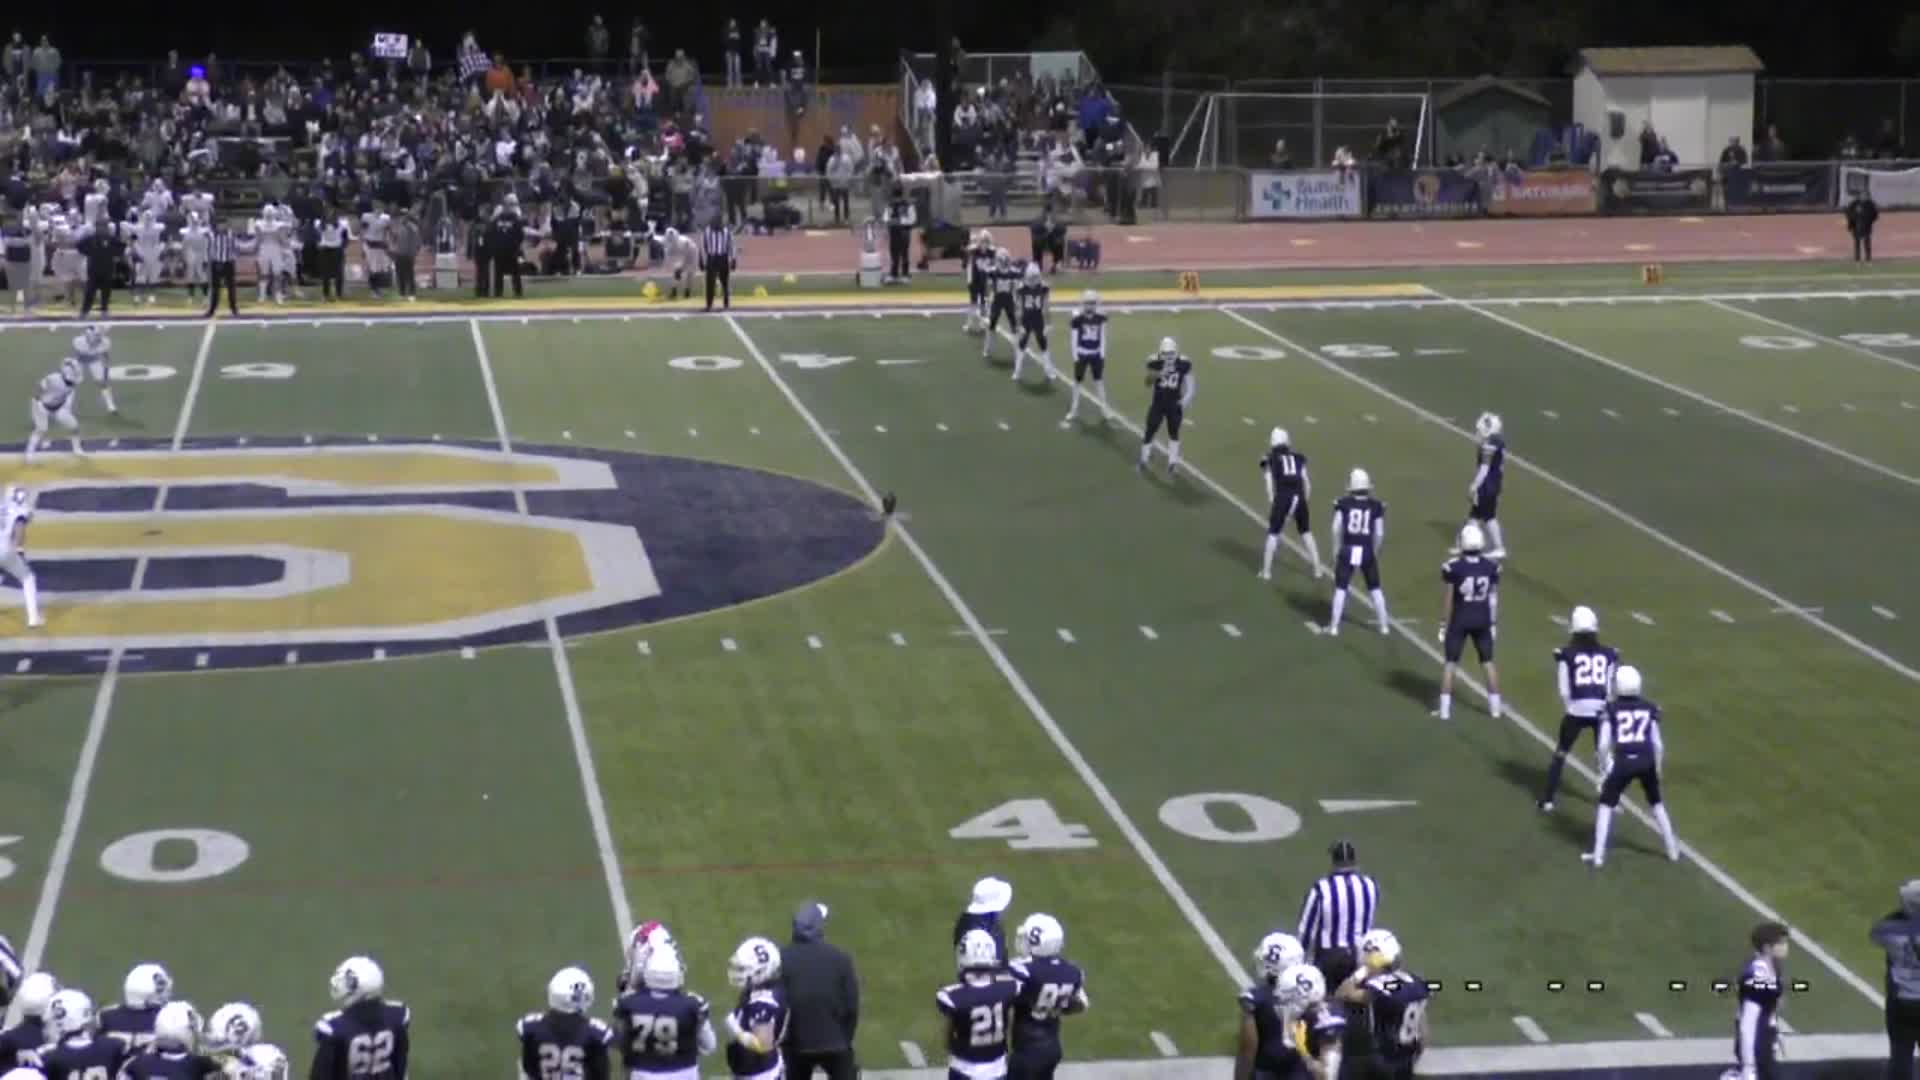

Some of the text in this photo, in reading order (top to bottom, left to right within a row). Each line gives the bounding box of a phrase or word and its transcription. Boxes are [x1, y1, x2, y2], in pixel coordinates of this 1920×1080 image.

[1281, 454, 1297, 475] 11
[1347, 508, 1371, 535] 81
[1459, 576, 1490, 602] 43
[1574, 655, 1607, 685] 28
[1616, 710, 1650, 743] 27
[753, 944, 769, 964] S
[632, 1014, 678, 1056] 79
[970, 1002, 1004, 1046] 21
[348, 1030, 394, 1075] 62
